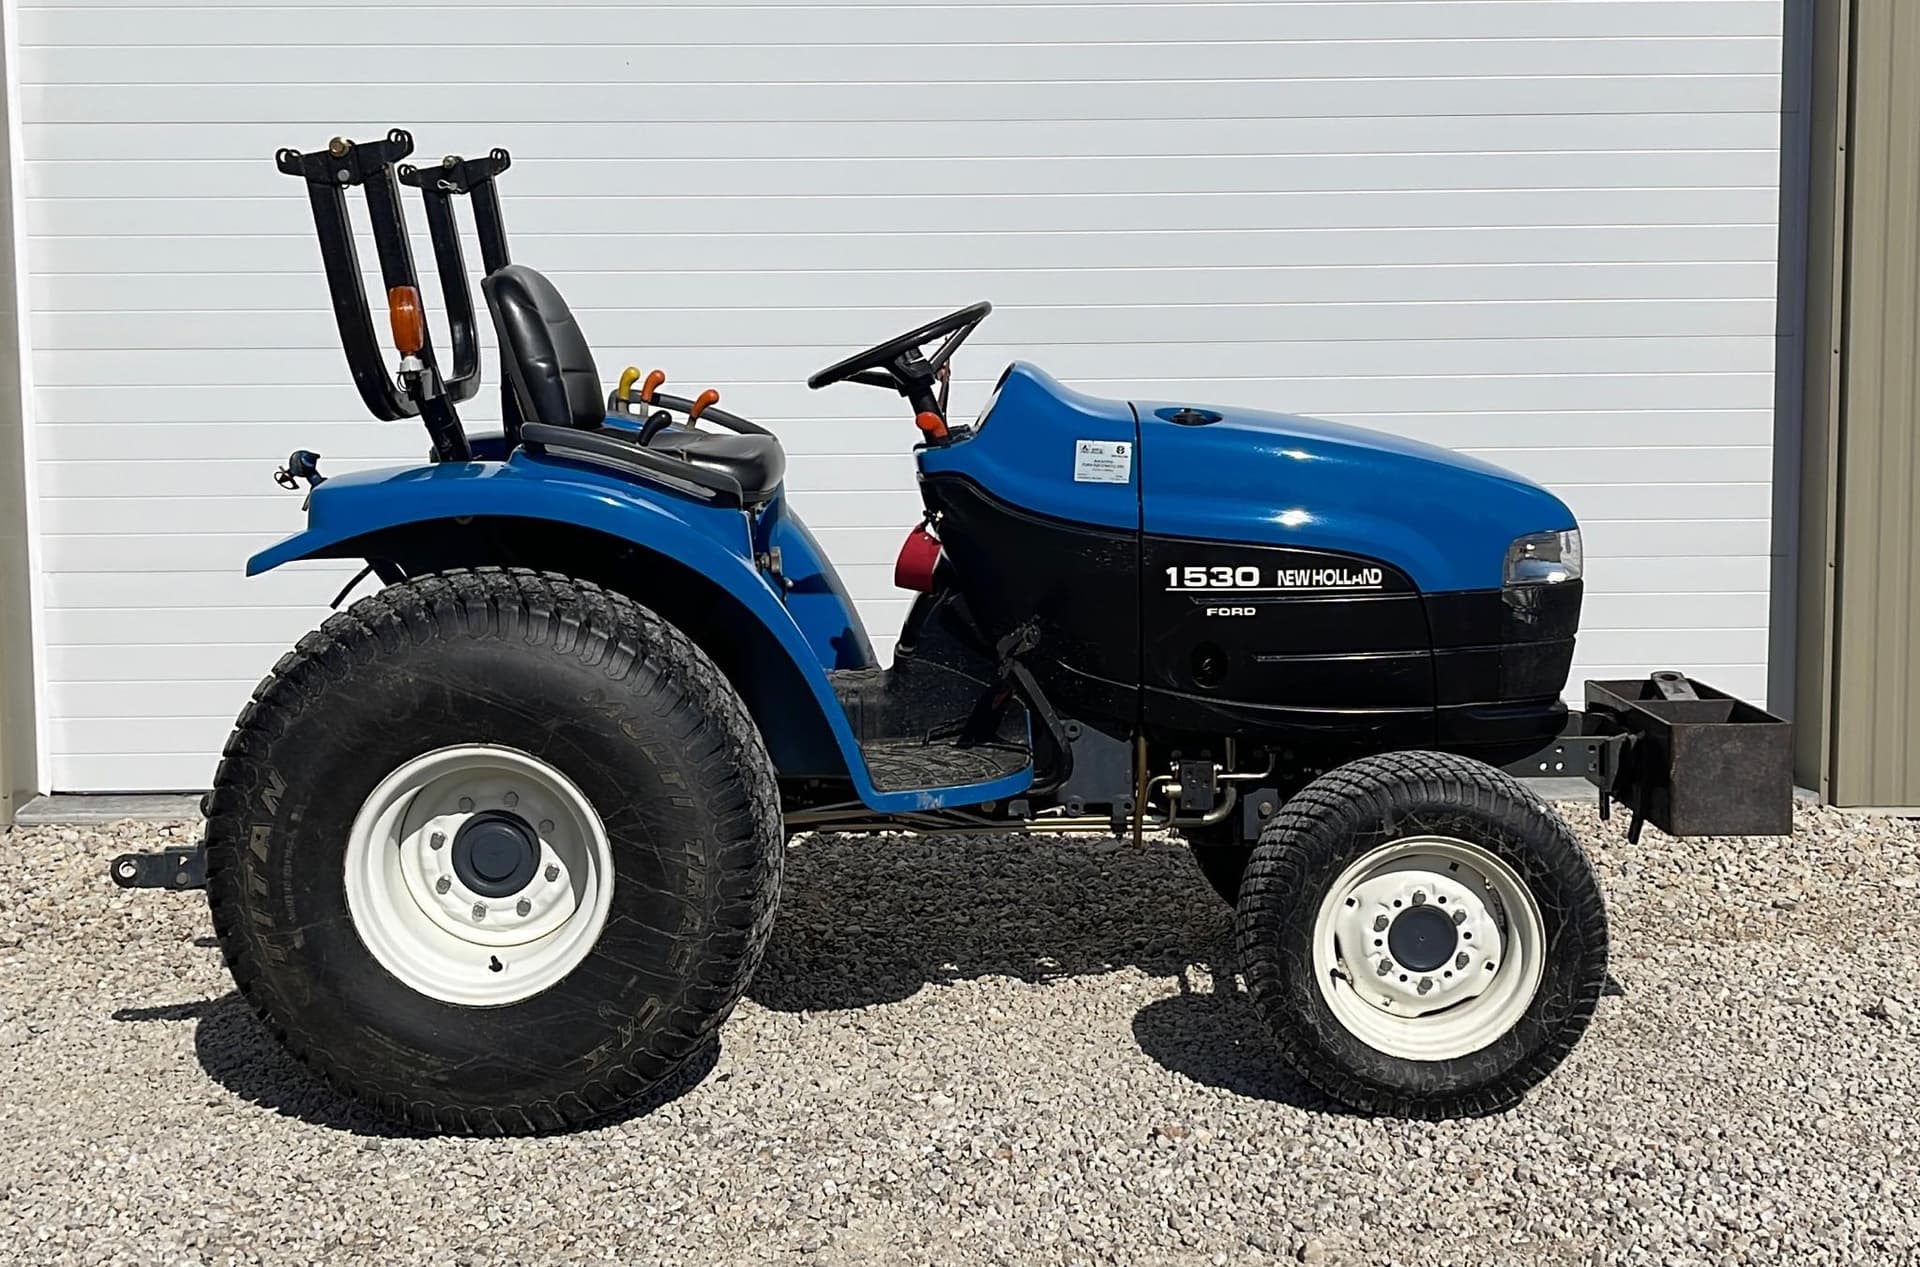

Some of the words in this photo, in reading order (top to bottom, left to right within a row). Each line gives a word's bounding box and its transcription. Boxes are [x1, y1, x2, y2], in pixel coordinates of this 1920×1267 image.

[1165, 566, 1260, 587] 1530
[1277, 569, 1310, 586] NEW
[1206, 607, 1256, 616] FORD
[248, 767, 288, 967] TITAN
